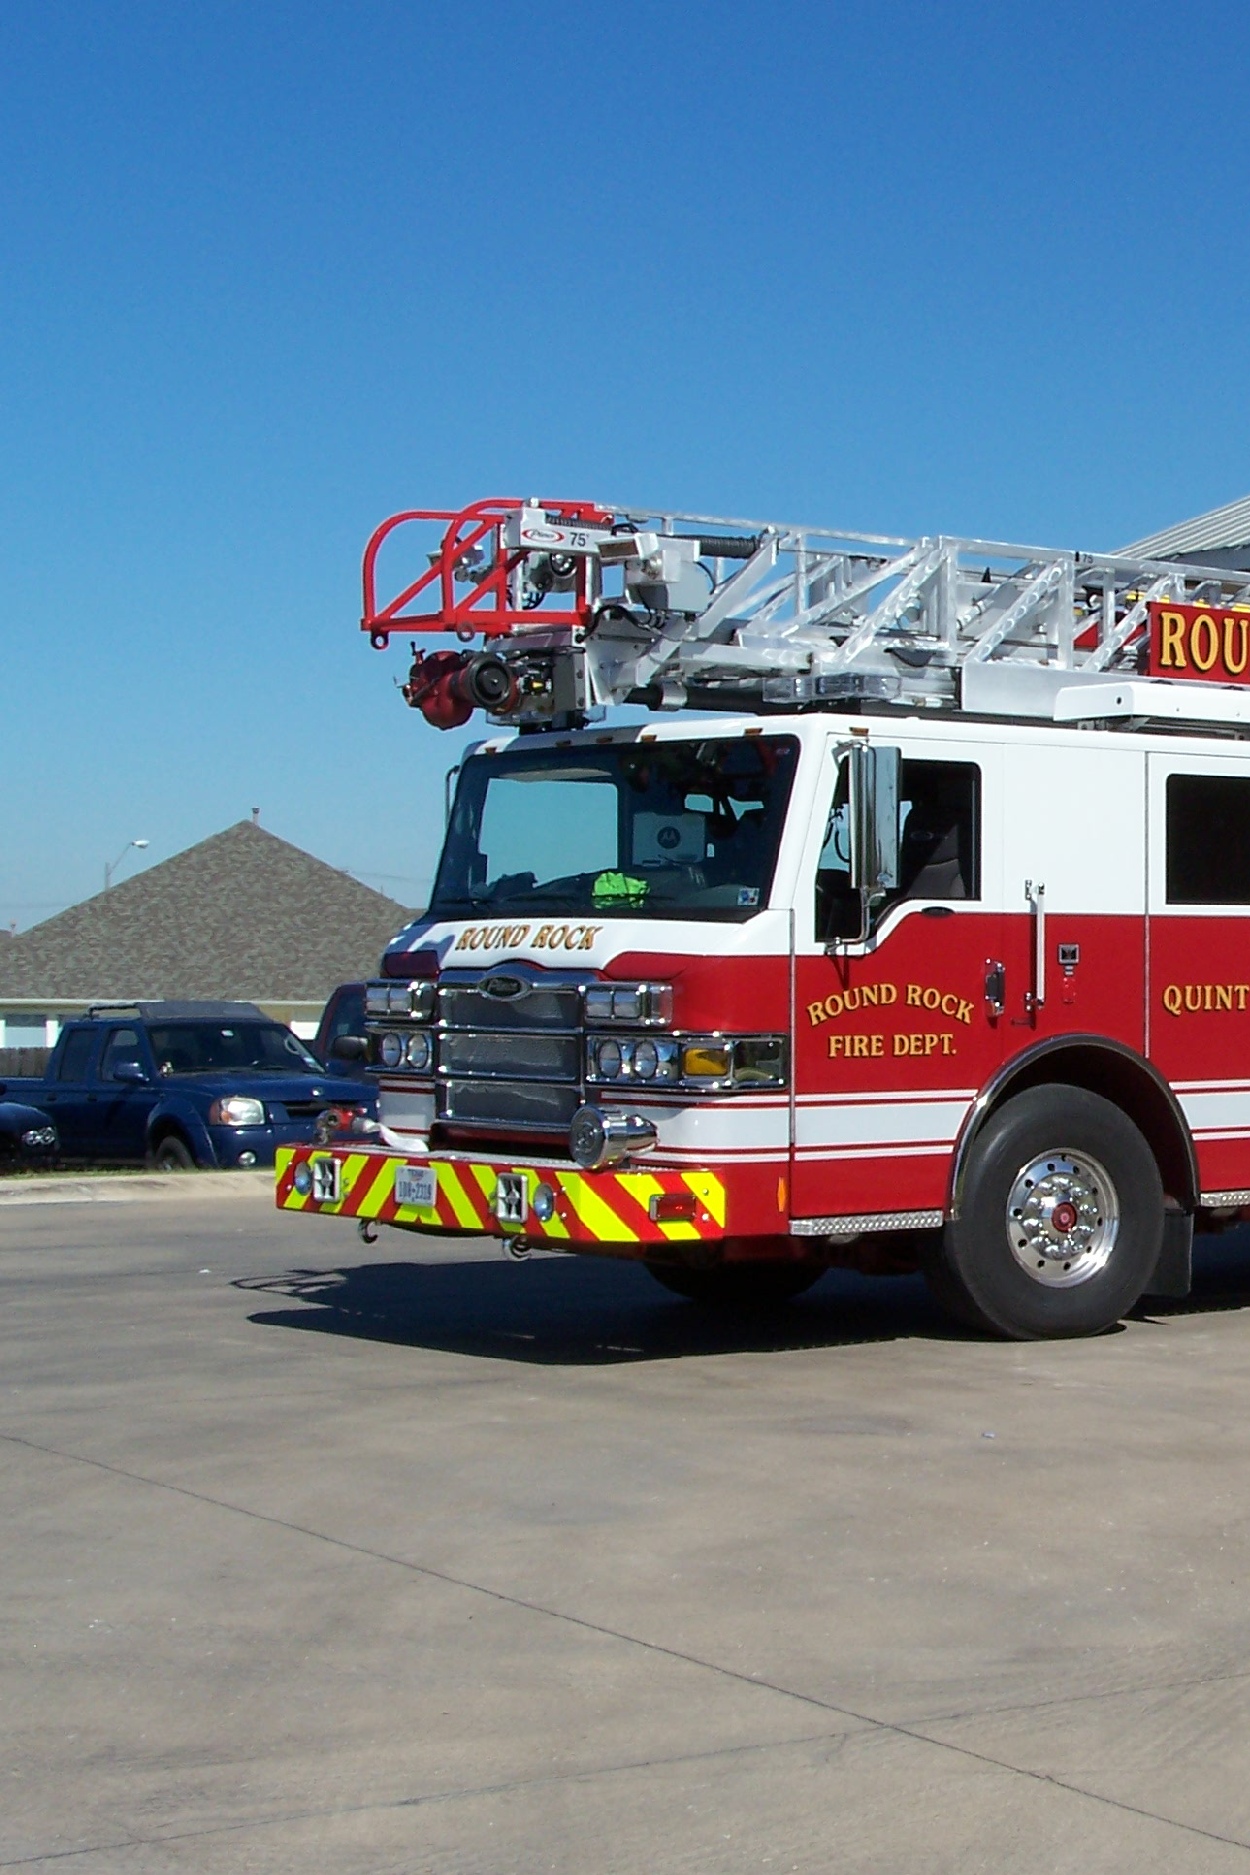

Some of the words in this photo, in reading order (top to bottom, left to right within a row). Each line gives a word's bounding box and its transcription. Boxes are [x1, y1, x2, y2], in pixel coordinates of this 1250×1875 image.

[455, 924, 531, 950] ROUND
[530, 924, 603, 950] ROCK
[806, 983, 898, 1026] ROUND
[906, 984, 975, 1025] ROCK
[1163, 984, 1250, 1016] QUINT
[828, 1034, 885, 1058] FIRE
[893, 1033, 957, 1056] DEPT.
